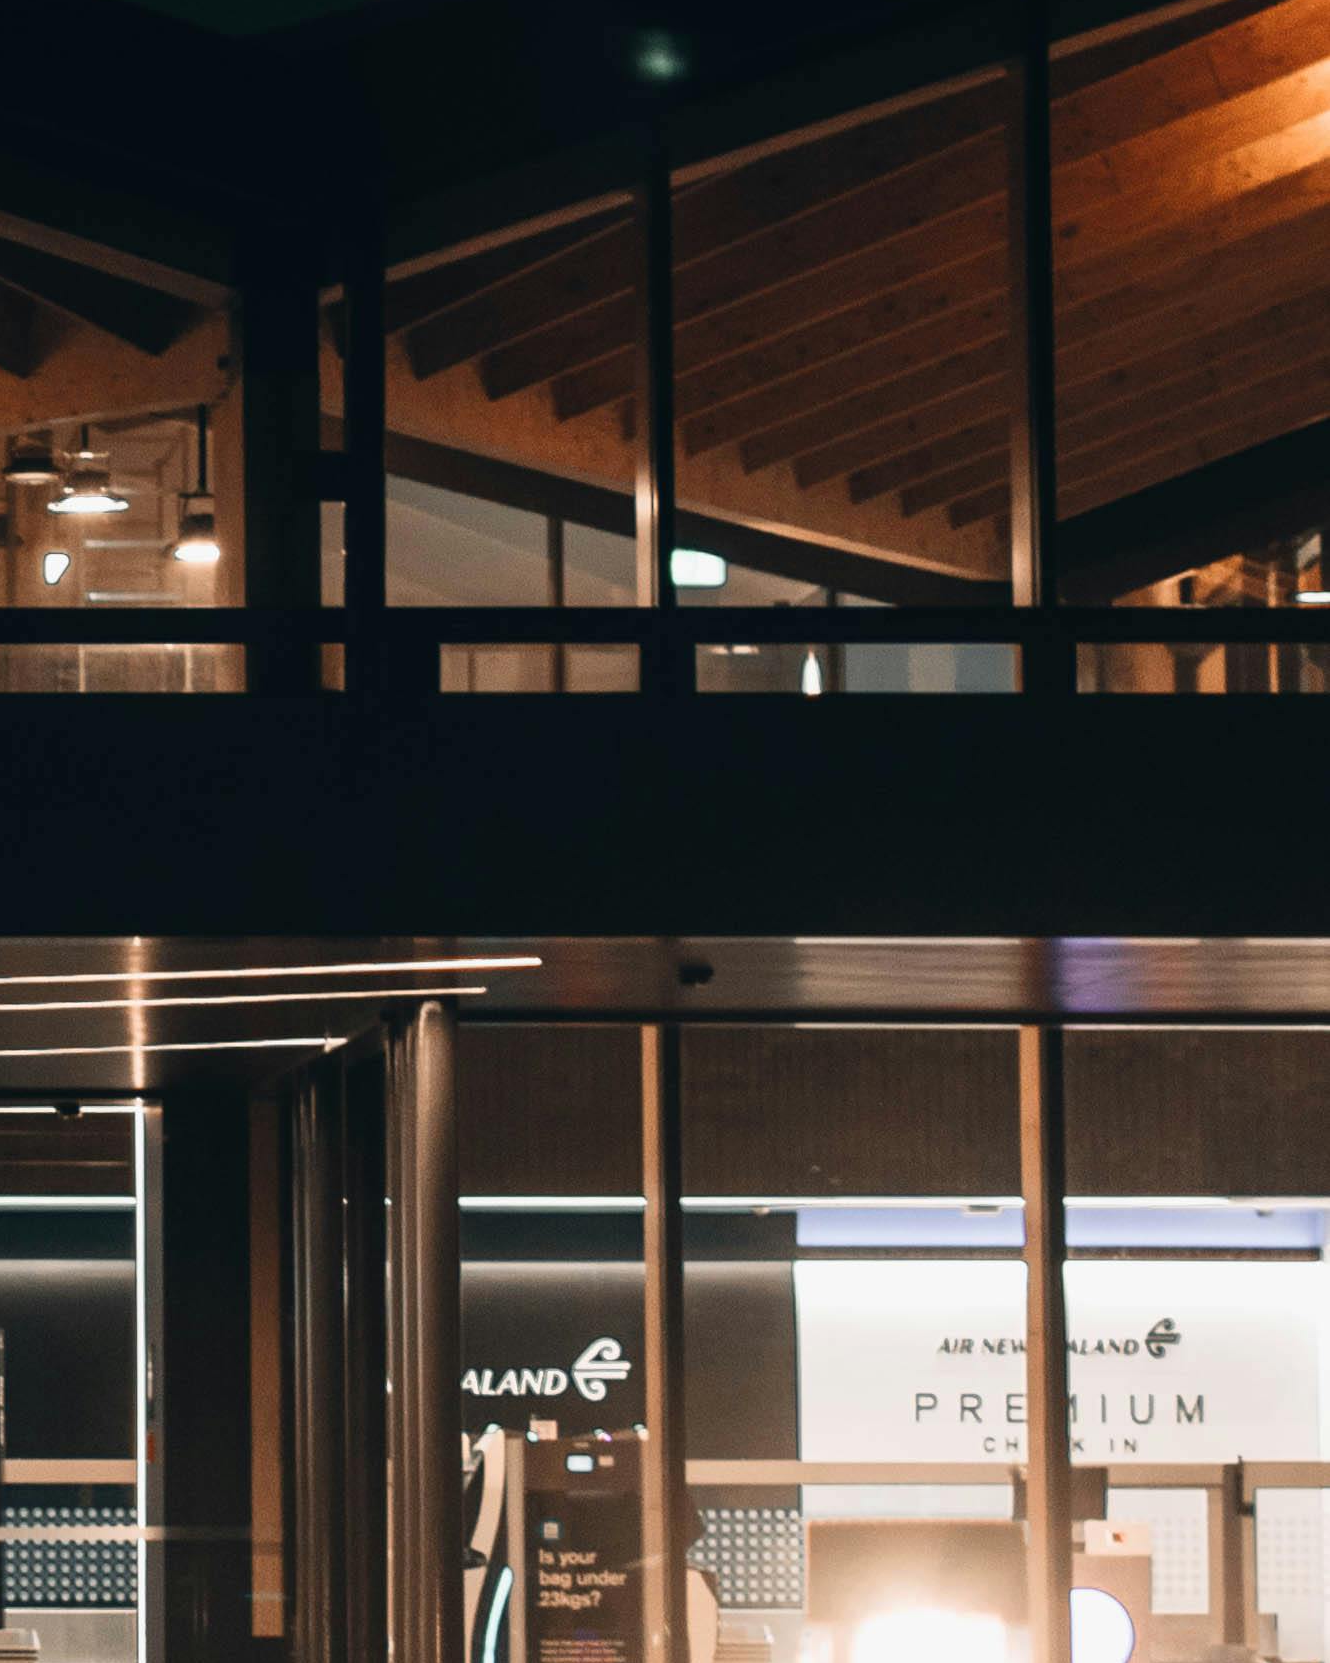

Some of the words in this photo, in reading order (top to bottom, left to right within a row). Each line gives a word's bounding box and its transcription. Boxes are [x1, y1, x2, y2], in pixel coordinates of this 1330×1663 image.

[937, 1337, 975, 1356] AIR
[462, 1368, 569, 1396] ALAND
[983, 1437, 1085, 1453] CHK
[1109, 1438, 1138, 1453] IN
[559, 1551, 596, 1568] your
[539, 1569, 572, 1589] bag
[576, 1570, 627, 1586] under
